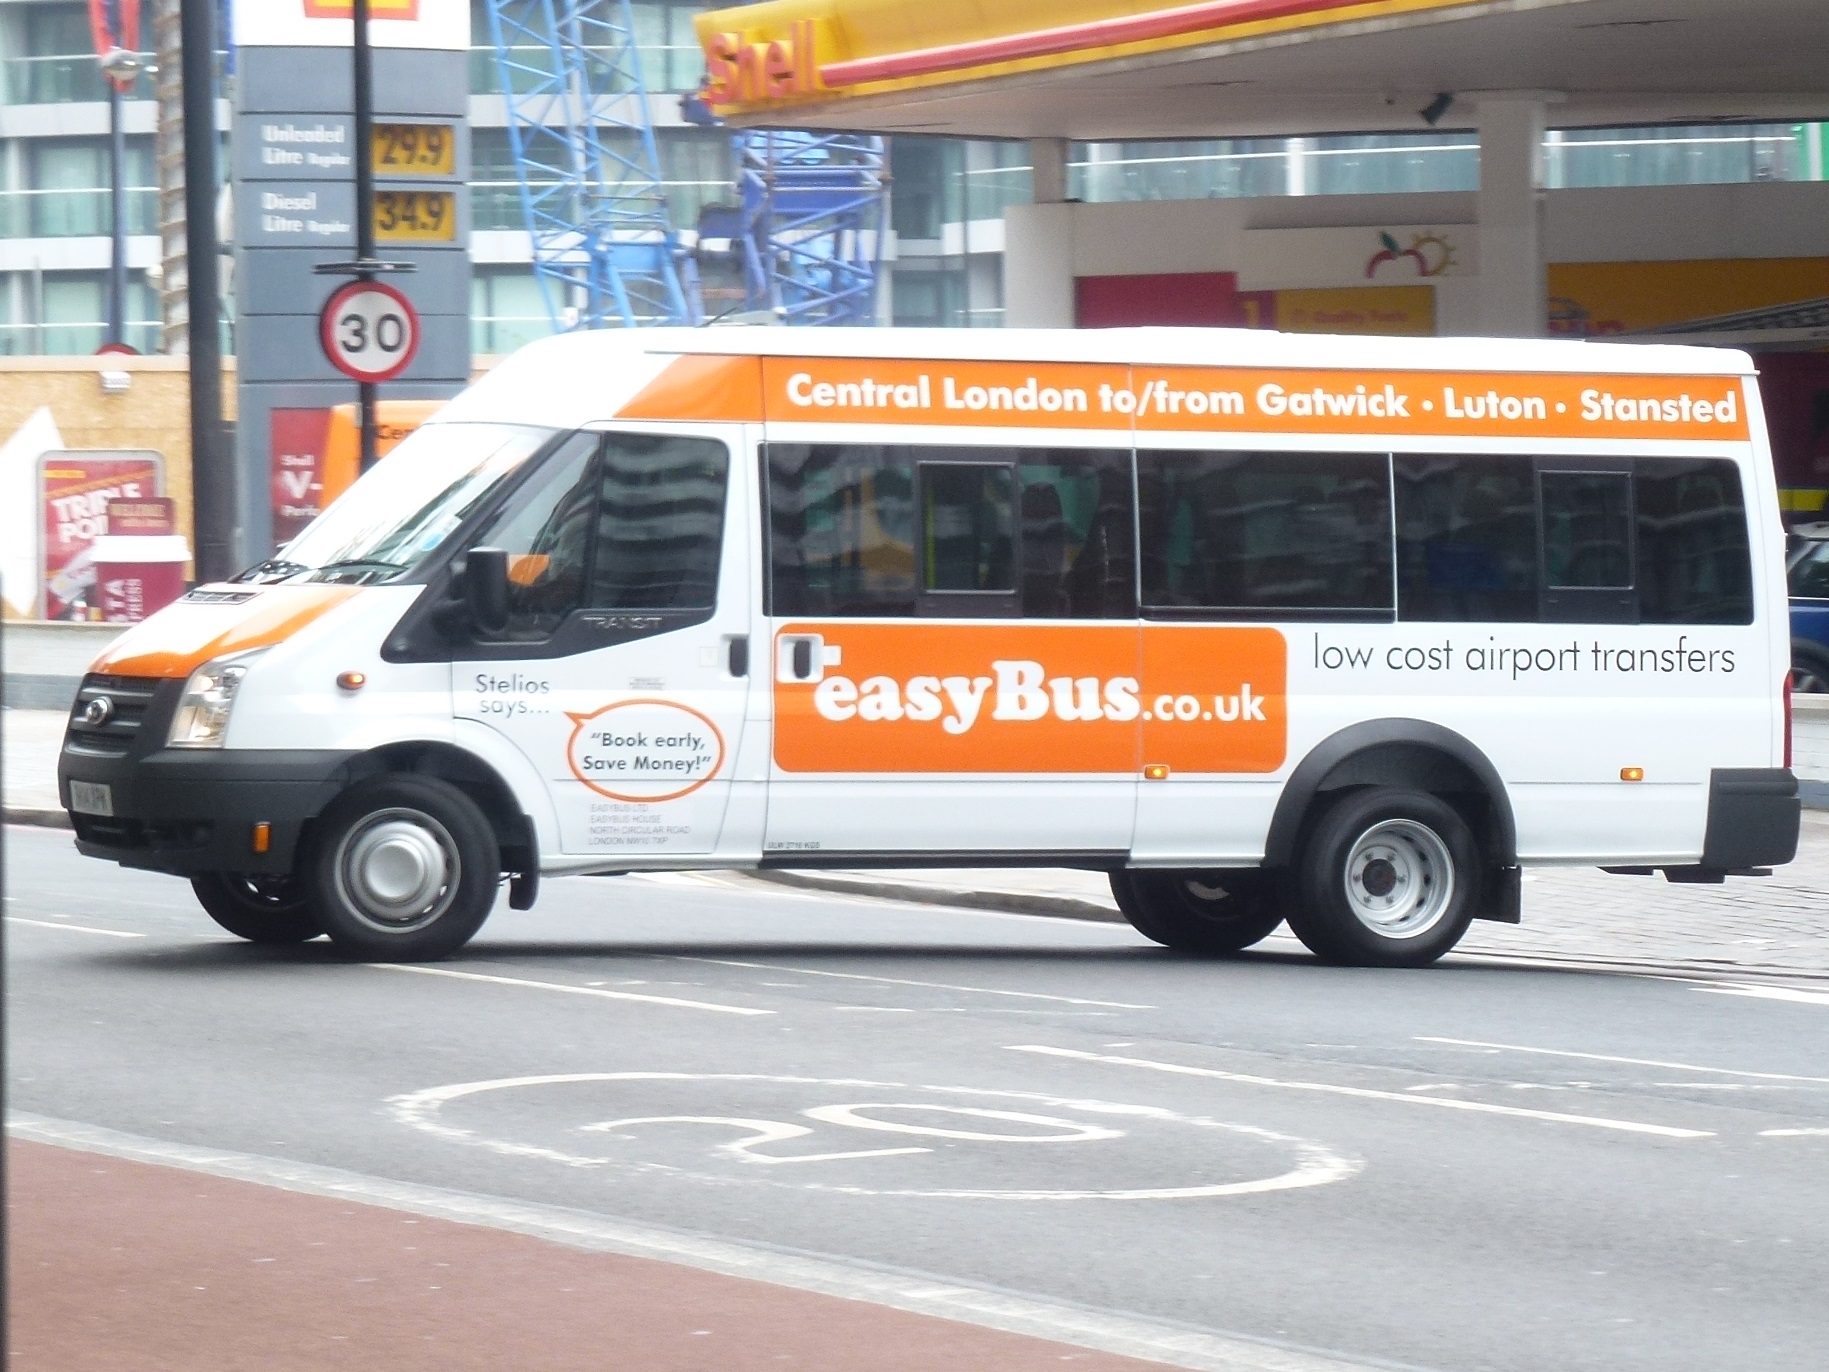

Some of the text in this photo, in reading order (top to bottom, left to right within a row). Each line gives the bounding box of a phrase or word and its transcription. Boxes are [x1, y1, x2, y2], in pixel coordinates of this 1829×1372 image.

[706, 18, 815, 105] Shell
[261, 125, 345, 143] Unleaded
[262, 147, 304, 165] Litre
[262, 192, 317, 210] Diesel
[262, 214, 304, 232] Litre
[340, 313, 404, 353] 30
[786, 373, 1738, 423] Central London to/from Gatwick Luton Stansted
[1313, 632, 1736, 680] low cost airport transfers
[475, 673, 550, 694] Stelios
[814, 659, 1267, 735] easyBus.co.uk
[655, 731, 706, 750] early,
[582, 755, 627, 771] Save
[588, 836, 624, 846] LONDON
